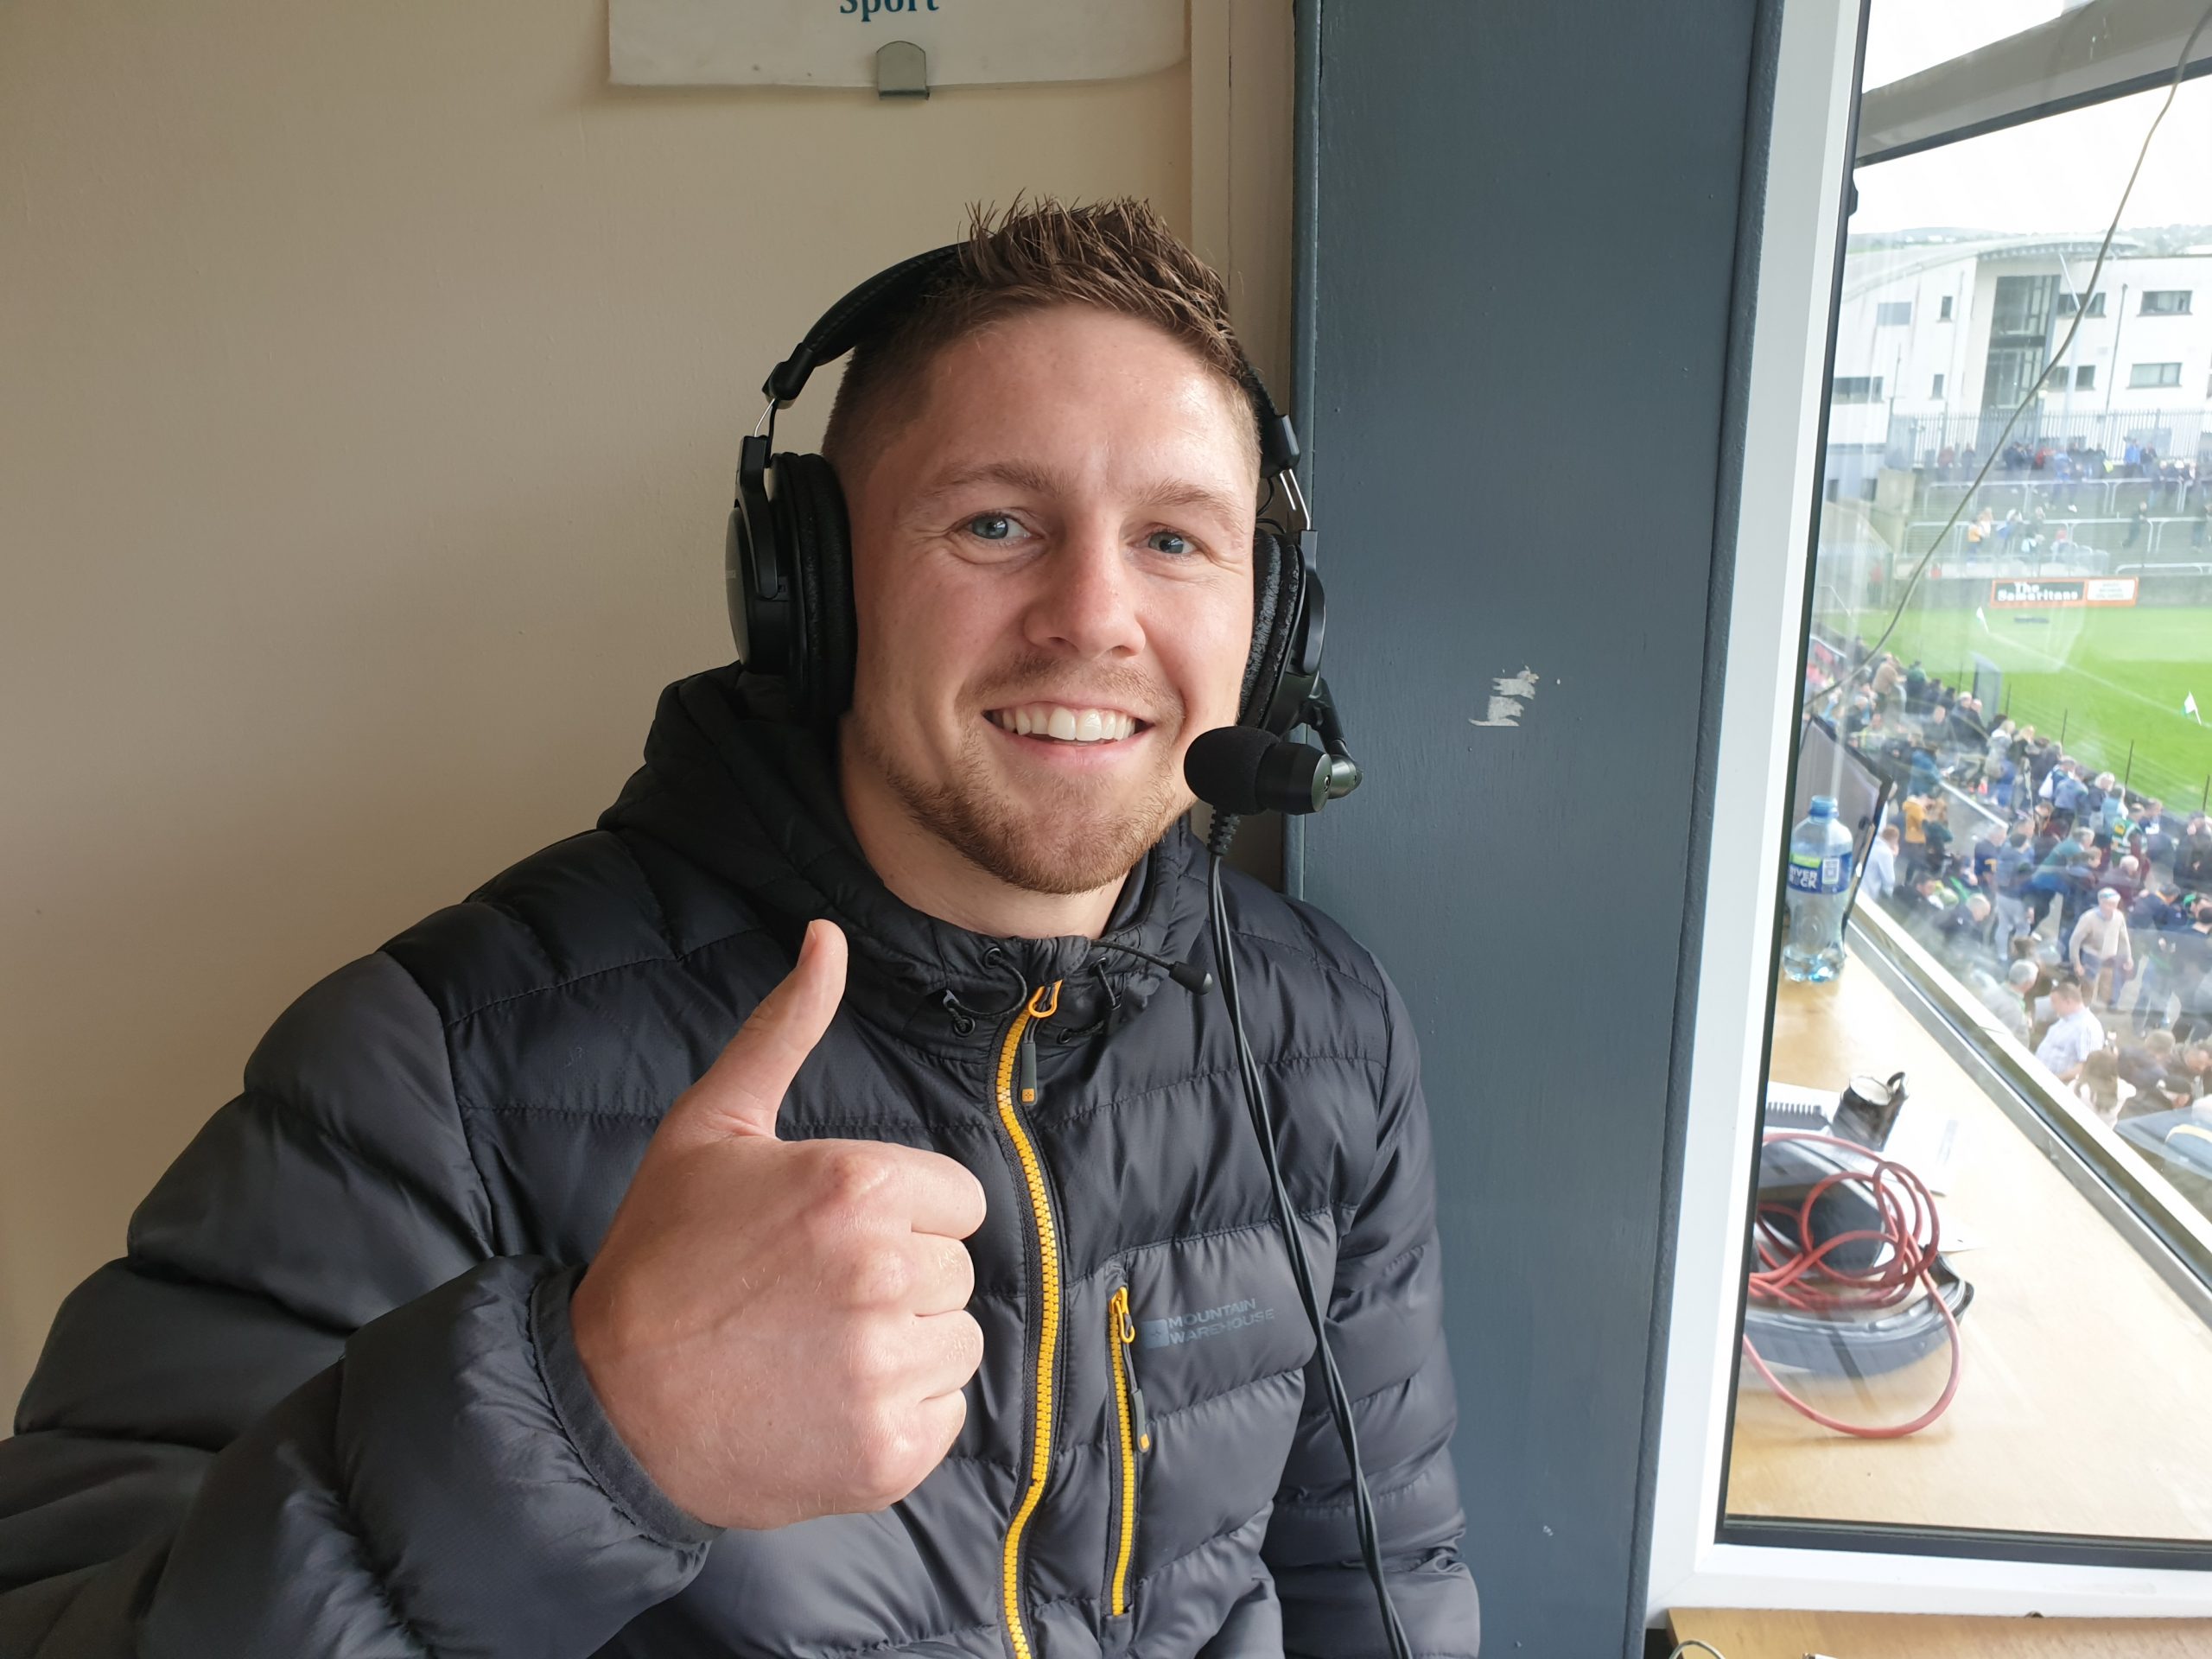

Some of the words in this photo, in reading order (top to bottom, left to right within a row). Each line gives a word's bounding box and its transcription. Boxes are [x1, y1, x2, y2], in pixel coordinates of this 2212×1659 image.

[1998, 588, 2078, 601] Samaritans
[2014, 582, 2040, 592] The
[1167, 1298, 1256, 1328] MOUNTAIN
[1169, 1308, 1274, 1344] WAREHOUSE
